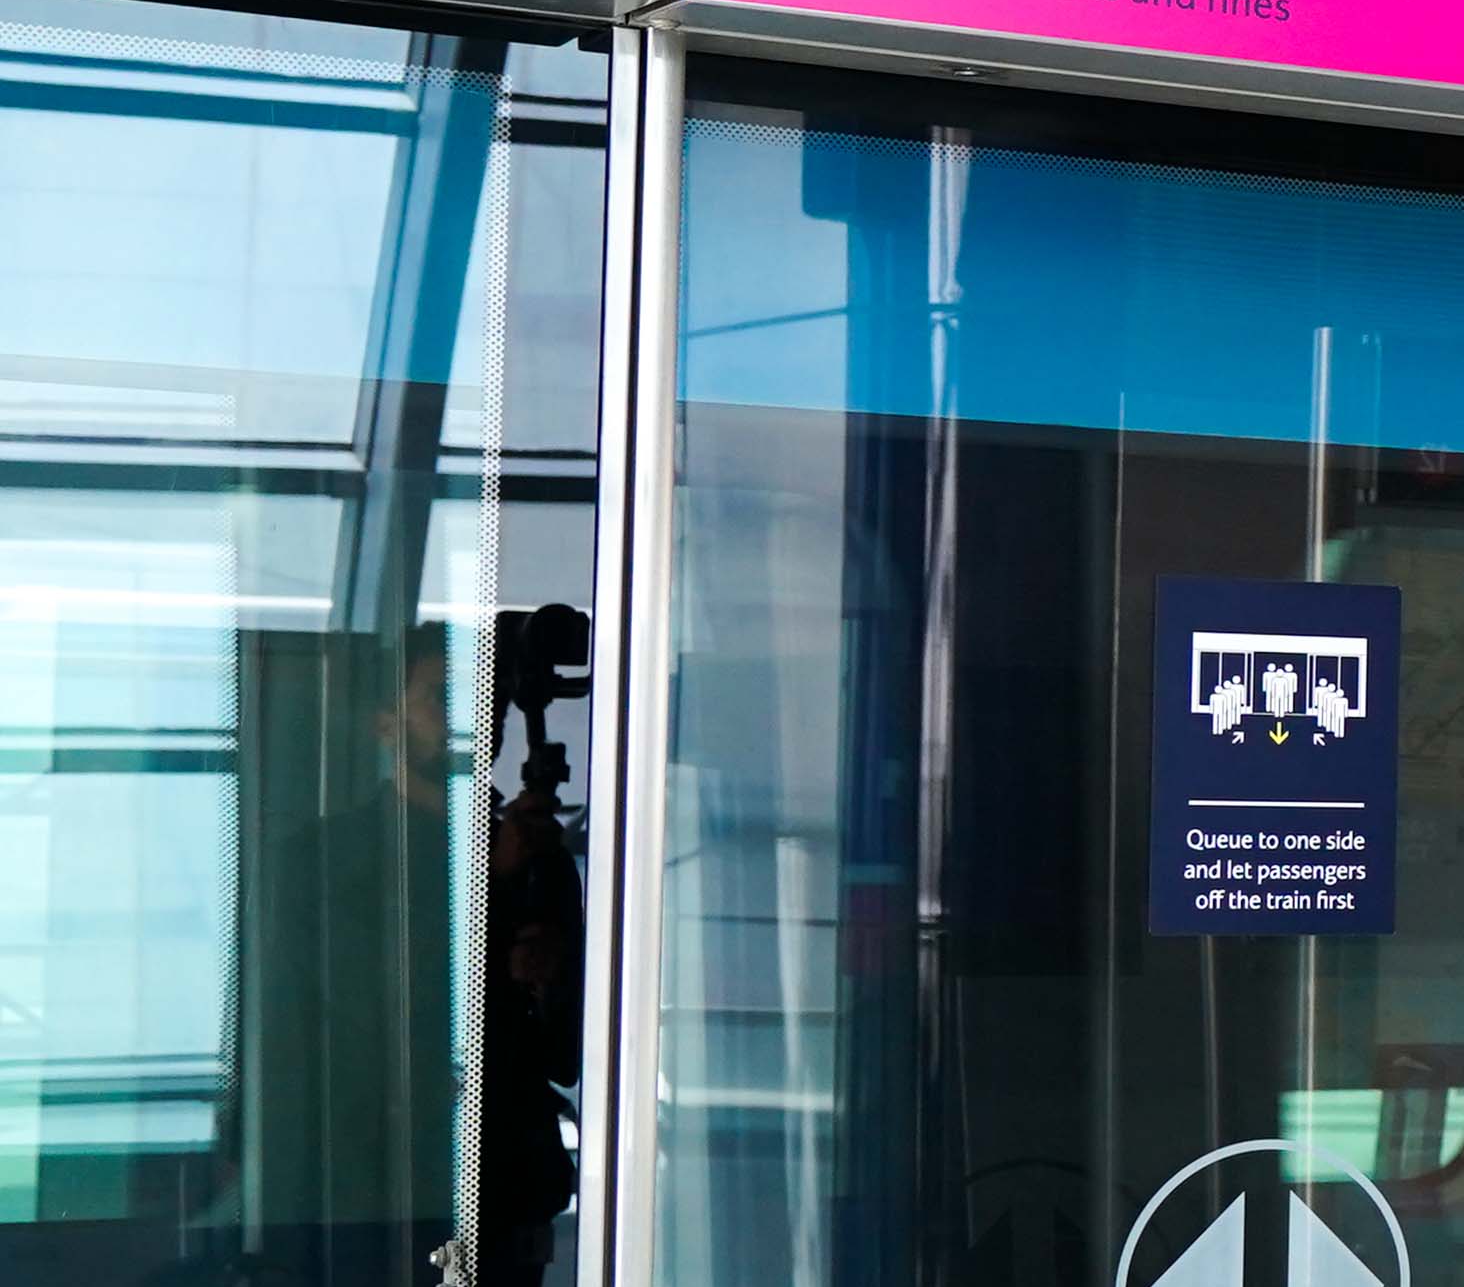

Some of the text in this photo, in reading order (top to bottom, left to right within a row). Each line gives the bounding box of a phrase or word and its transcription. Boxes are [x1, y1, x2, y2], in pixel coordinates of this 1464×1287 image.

[1186, 827, 1367, 852] Queue to one side
[1184, 860, 1367, 886] and let passengers
[1195, 889, 1356, 911] off the train first
